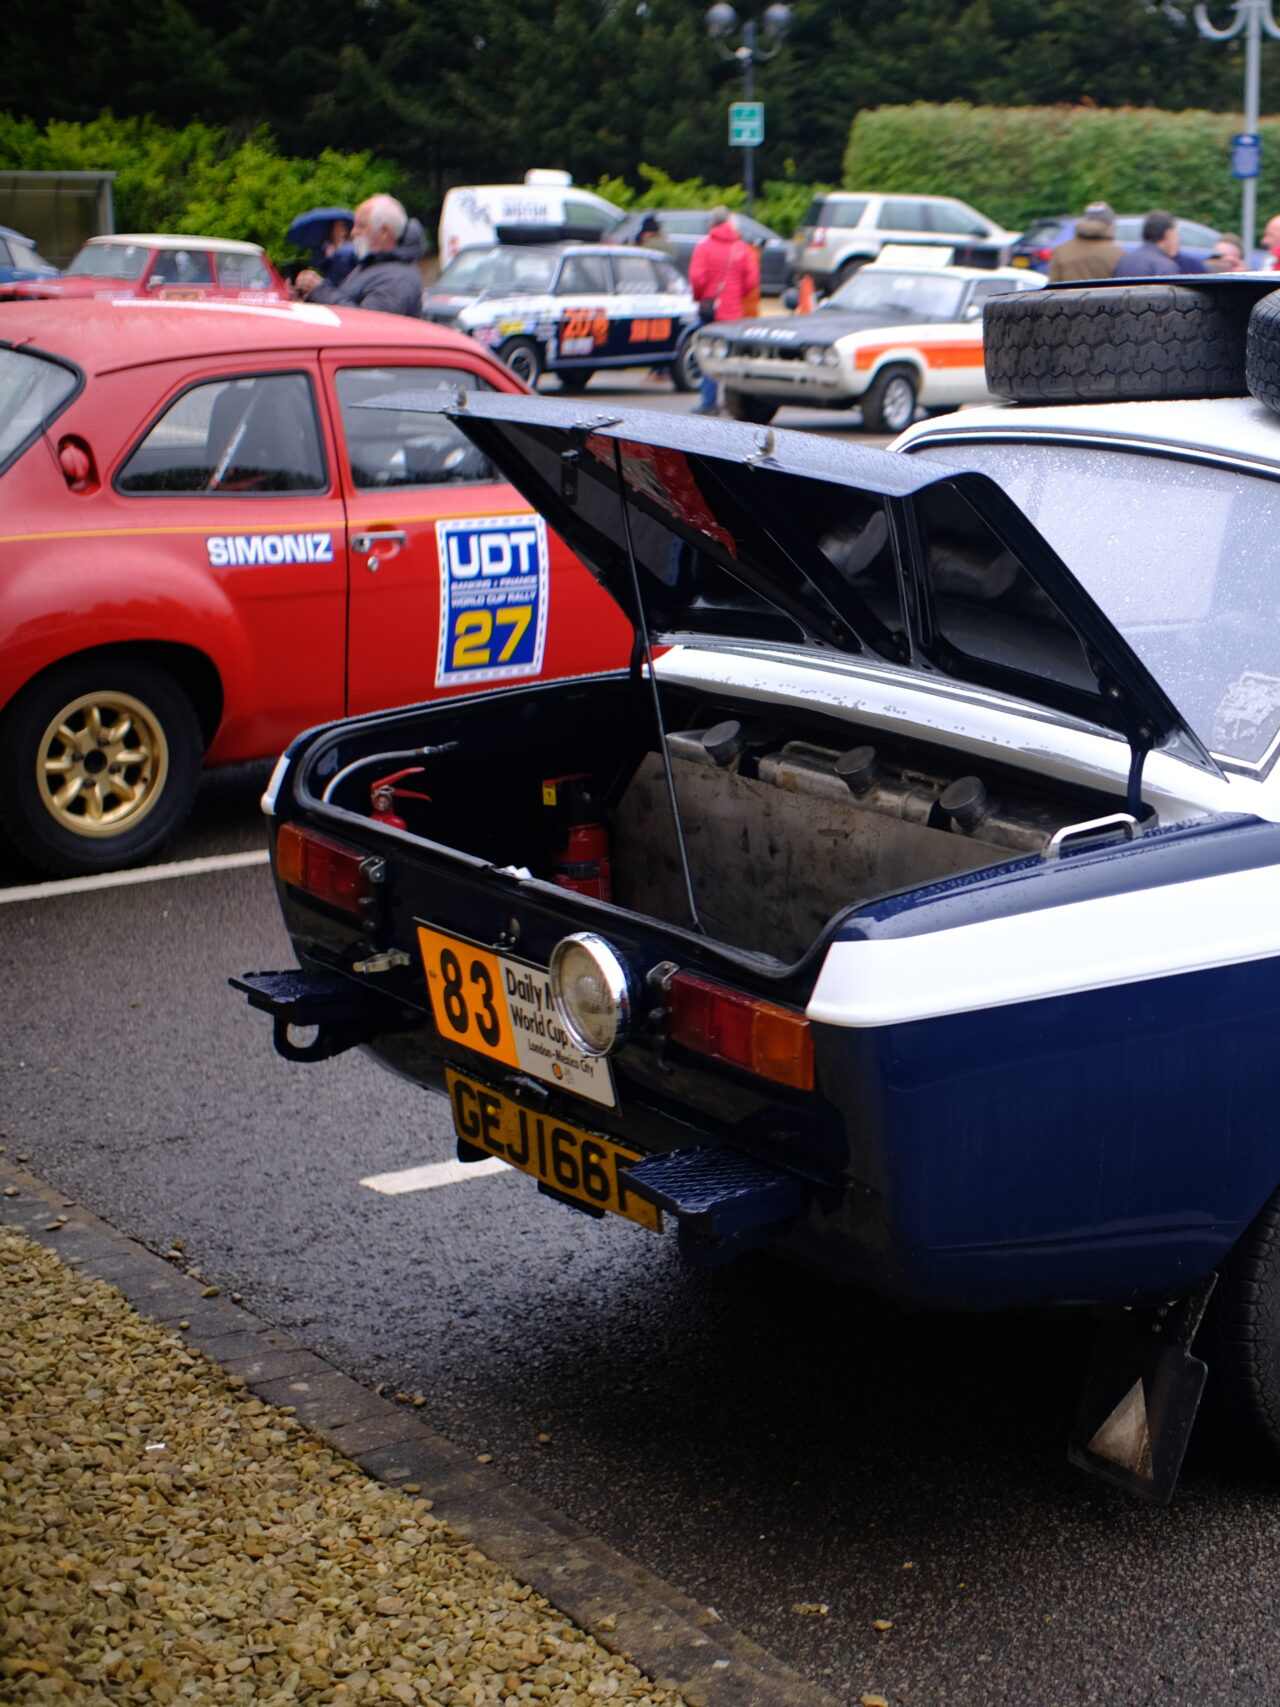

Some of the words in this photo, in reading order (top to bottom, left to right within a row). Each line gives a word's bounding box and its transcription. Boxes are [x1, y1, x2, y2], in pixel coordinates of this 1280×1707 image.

[206, 532, 334, 567] SIMONIZ
[448, 531, 537, 579] UDT
[507, 590, 537, 604] RALLY
[452, 605, 533, 668] 27
[439, 948, 501, 1047] 83
[505, 967, 542, 1011] Daily
[510, 1003, 546, 1037] World
[546, 1018, 569, 1048] Cup
[580, 1059, 594, 1078] City
